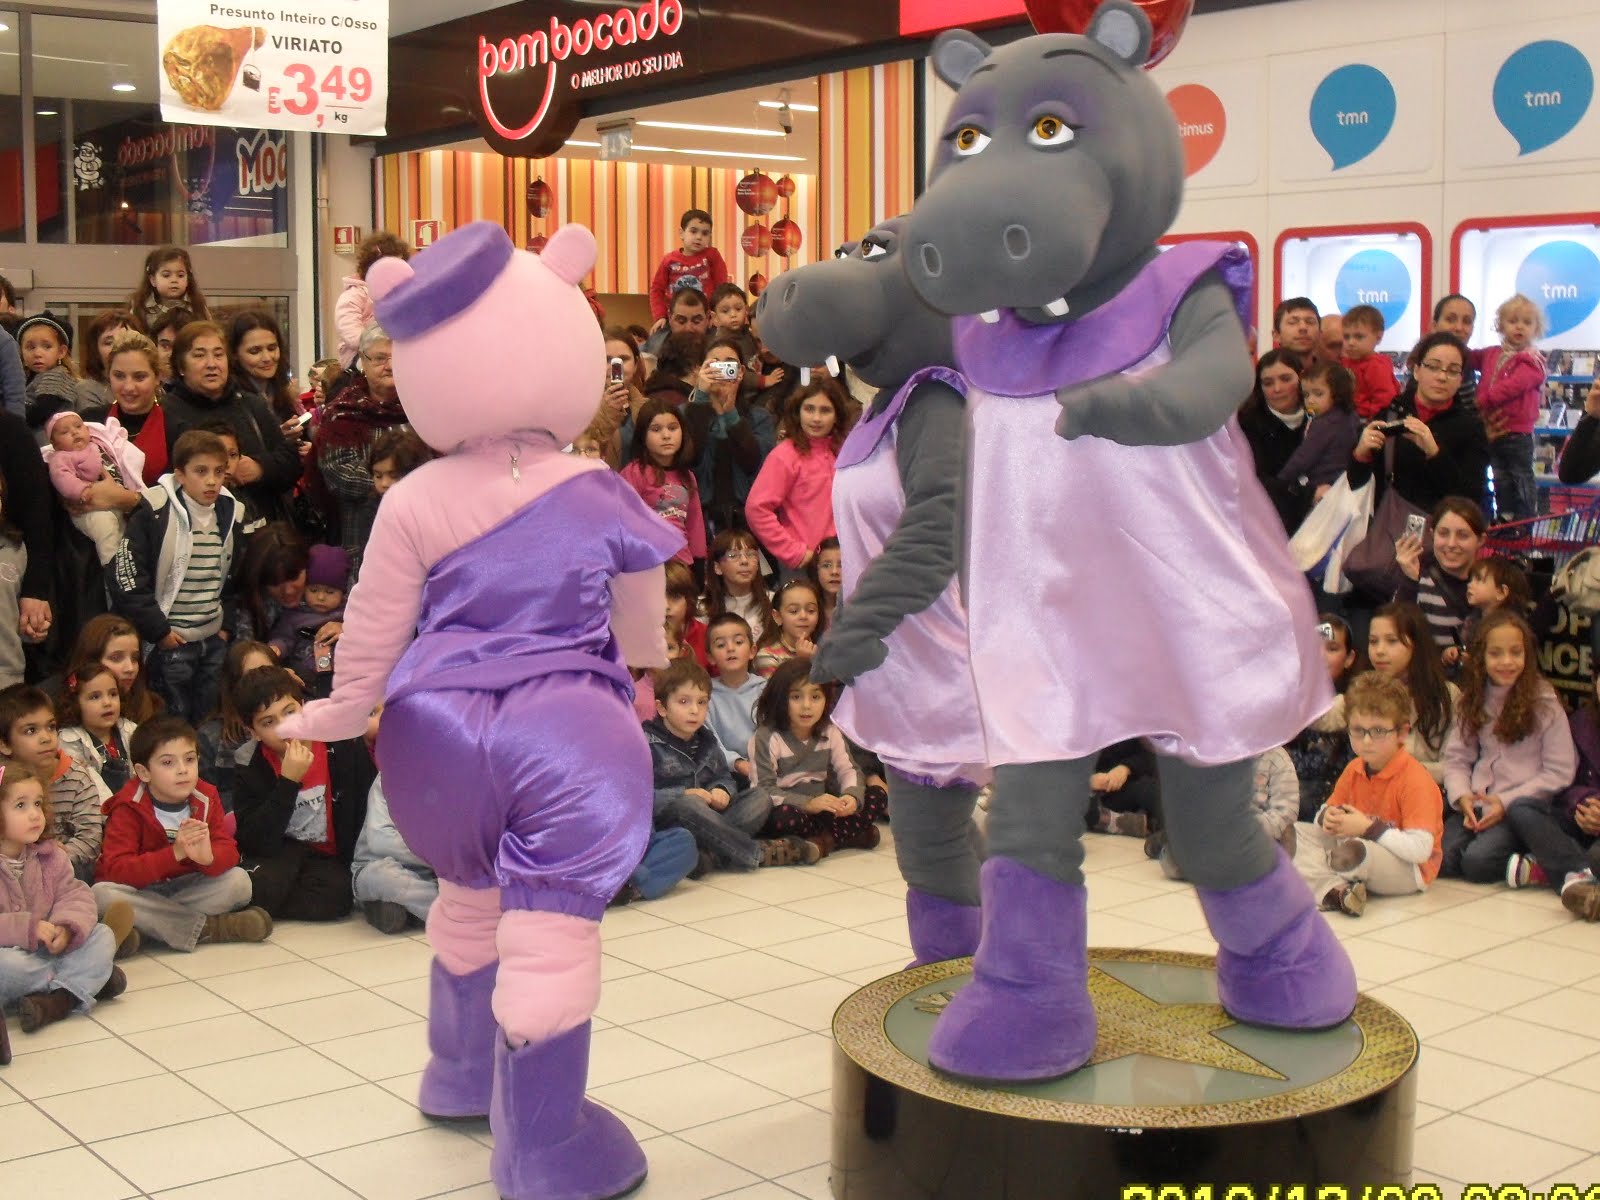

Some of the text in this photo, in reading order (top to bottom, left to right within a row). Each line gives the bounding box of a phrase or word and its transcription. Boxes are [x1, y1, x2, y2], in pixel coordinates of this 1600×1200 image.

[210, 3, 377, 31] Presunto Inteiro C/Osso
[271, 35, 343, 55] VIRIATO
[570, 50, 684, 90] O MELHOR DO SEU DIA
[1523, 91, 1562, 107] tmn
[334, 111, 348, 124] kg
[1336, 111, 1369, 126] tmn
[1356, 288, 1389, 303] tmn
[1541, 282, 1578, 299] tmn
